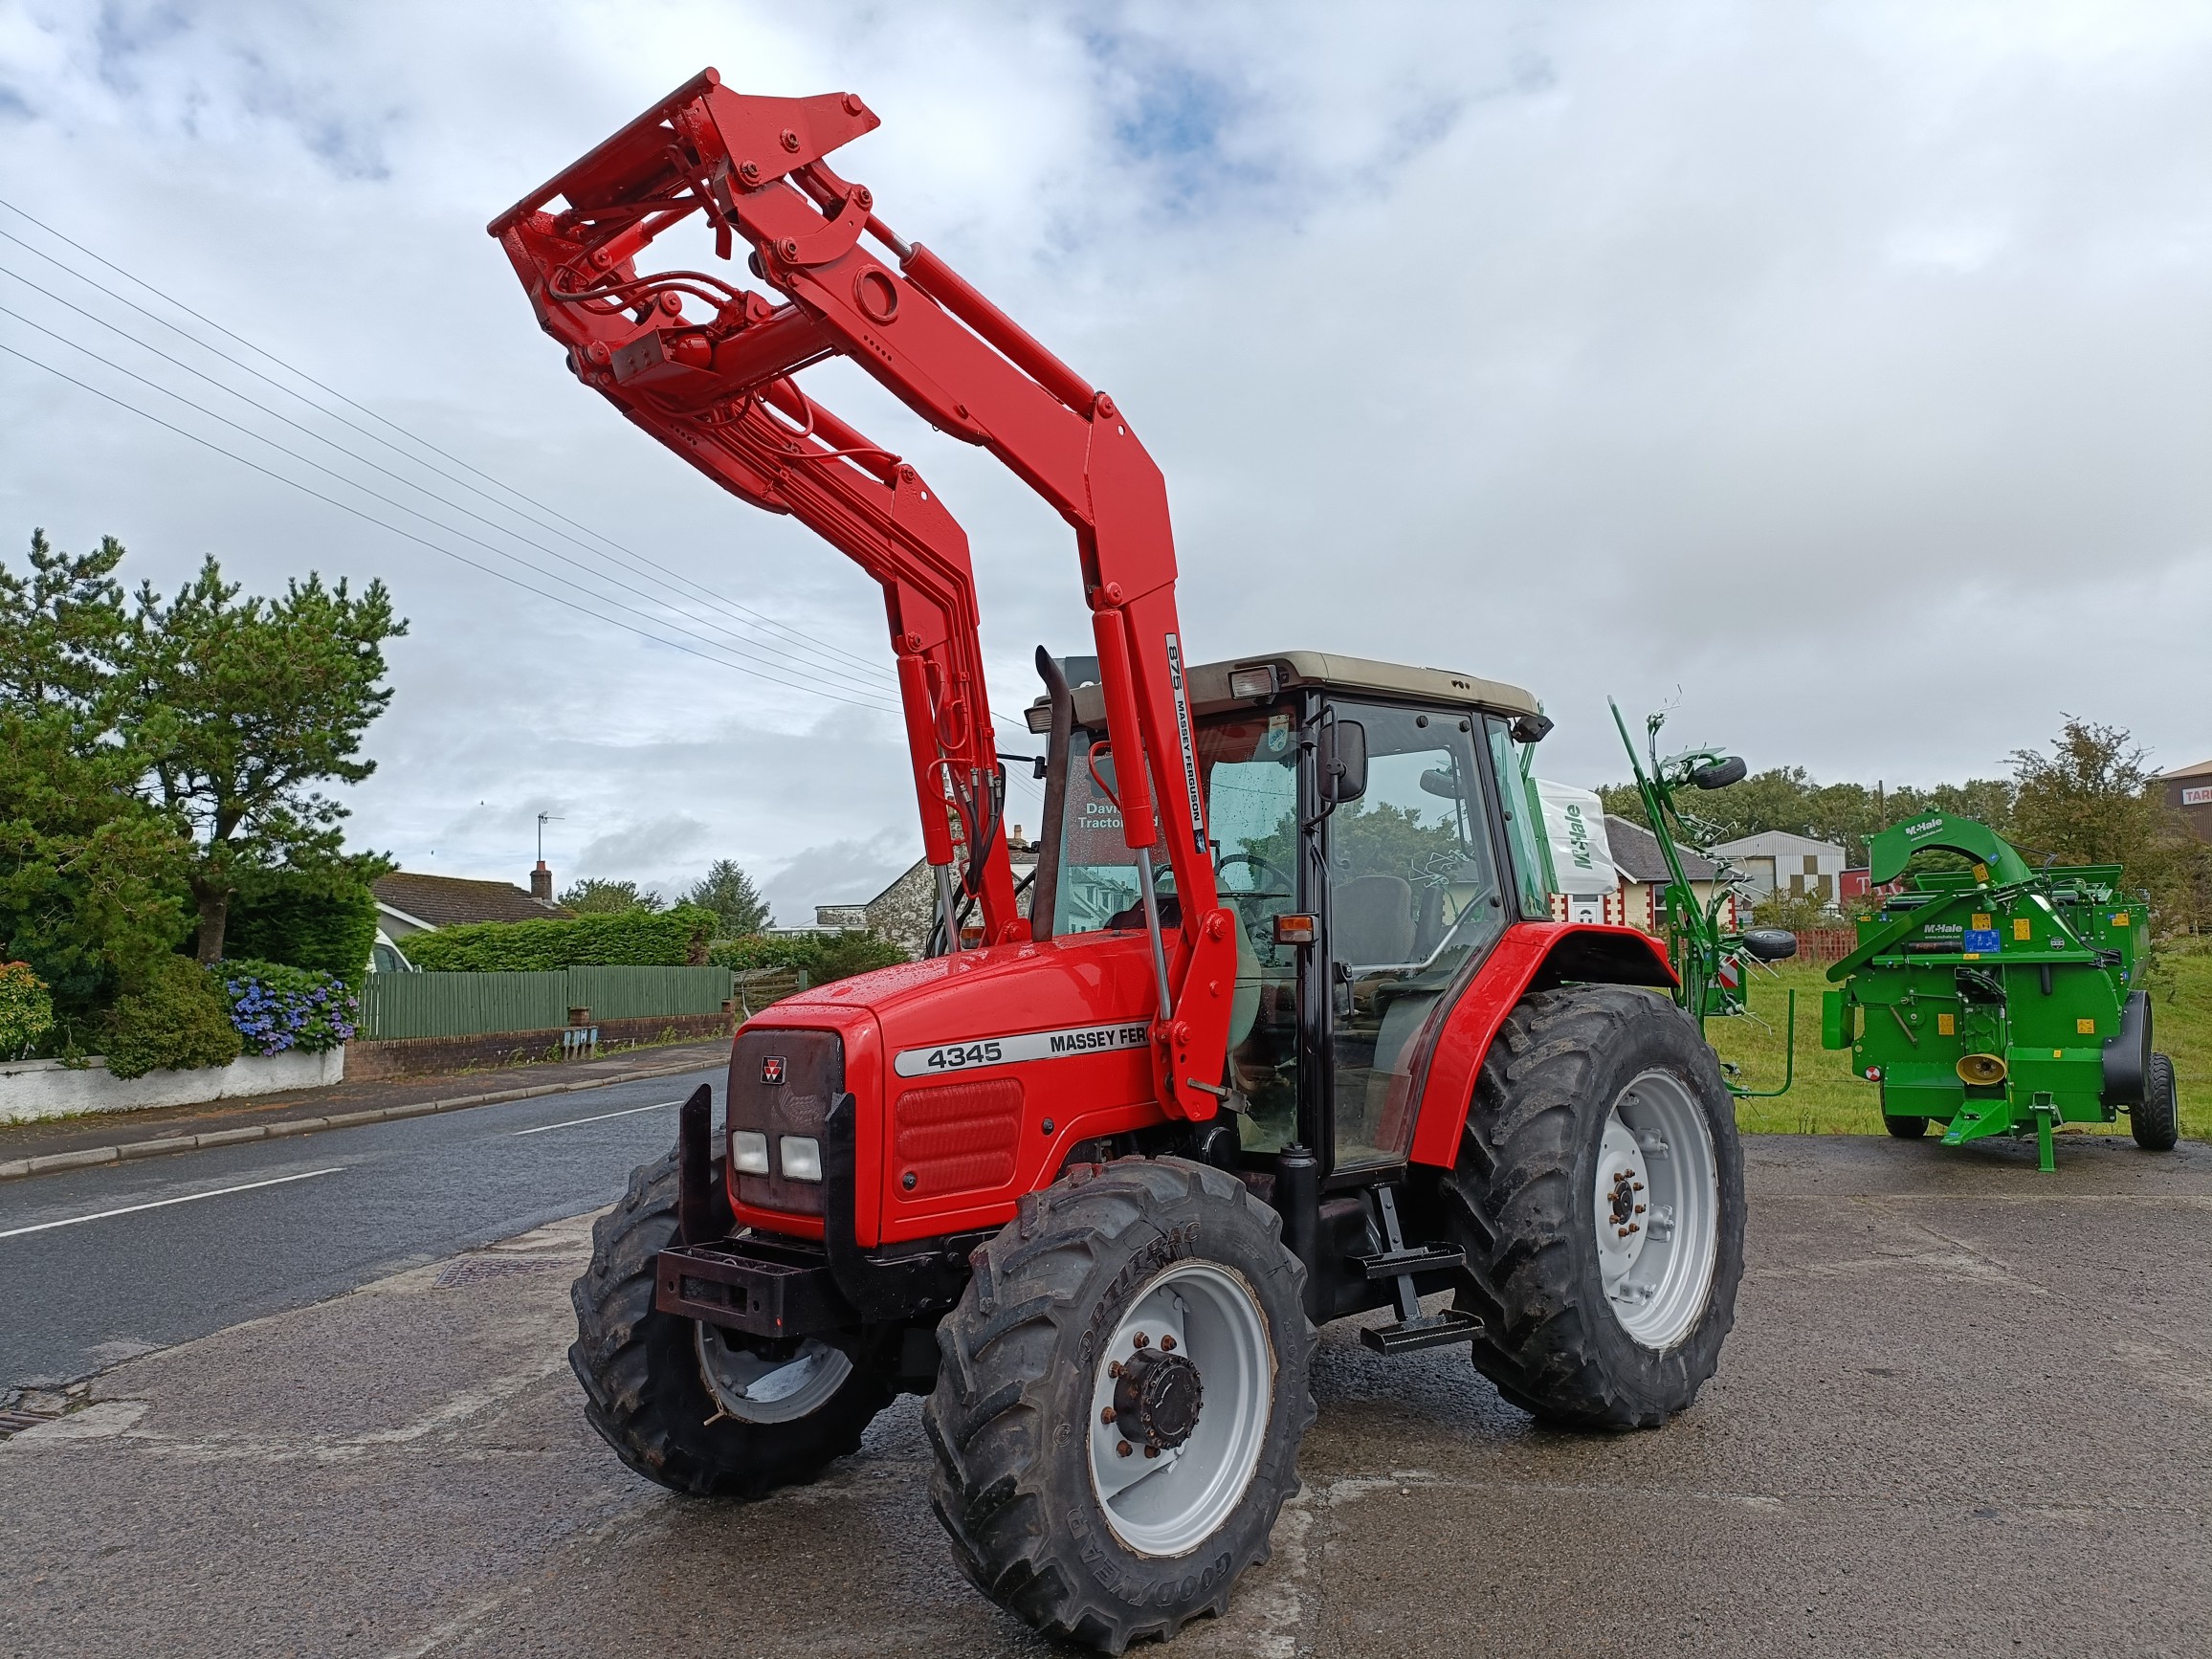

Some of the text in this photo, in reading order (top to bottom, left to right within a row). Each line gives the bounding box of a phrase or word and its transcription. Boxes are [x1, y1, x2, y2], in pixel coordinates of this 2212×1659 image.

[1168, 645, 1200, 822] 875 MASSEY FERGUSON
[2186, 789, 2212, 802] TAR
[1086, 803, 1121, 814] Davi
[1905, 818, 1943, 835] McHale
[1564, 804, 1593, 870] McHale
[1924, 924, 1963, 934] McHale
[927, 1042, 1003, 1069] 4345
[1050, 1029, 1117, 1052] MASSEY
